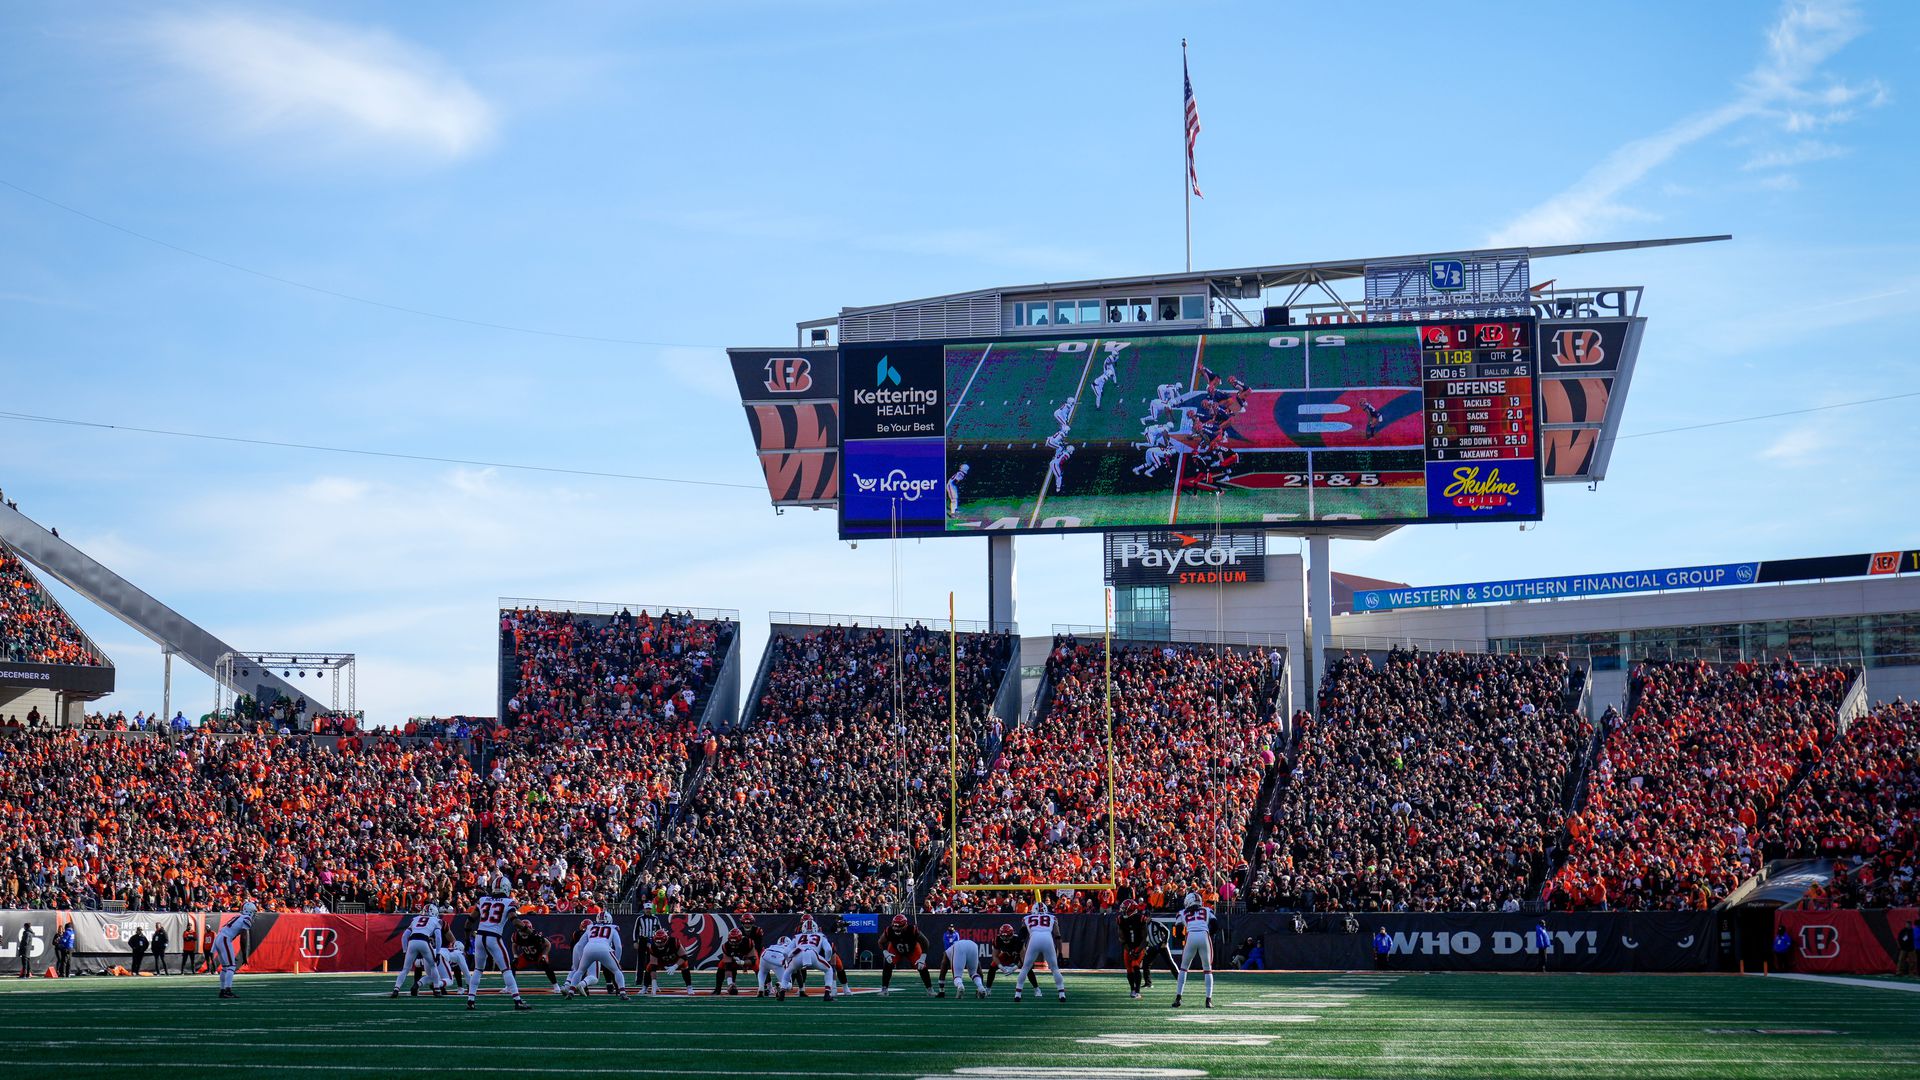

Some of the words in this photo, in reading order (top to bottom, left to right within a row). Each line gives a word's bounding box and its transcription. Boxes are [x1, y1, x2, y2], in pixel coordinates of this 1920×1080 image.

[1480, 290, 1525, 303] BANK
[1458, 330, 1467, 342] 0
[1511, 328, 1521, 340] 7
[1435, 351, 1472, 364] 11:03
[1490, 352, 1506, 360] QTR
[1512, 349, 1522, 362] 2
[1430, 369, 1450, 379] 2ND
[1459, 368, 1466, 377] 5
[1514, 366, 1527, 375] 45
[1447, 381, 1506, 395] DEFENSE
[854, 387, 938, 407] Kettering
[1434, 400, 1445, 409] 19
[1463, 399, 1491, 408] TACKLES
[1509, 397, 1520, 407] 13
[877, 404, 925, 416] HEALTH
[1432, 413, 1447, 422] 0.0
[1467, 412, 1489, 421] SACKS
[1507, 410, 1523, 419] 2.0
[877, 424, 889, 433] Be
[890, 423, 912, 432] Your
[913, 422, 934, 432] Best
[1437, 425, 1443, 434] 0
[1512, 423, 1518, 432] 0
[1433, 437, 1448, 447] 0.0
[1460, 437, 1473, 446] 3RD
[1474, 437, 1493, 445] DOWN
[1505, 435, 1527, 445] 25.0
[1438, 450, 1444, 459] 0
[1460, 450, 1498, 458] TAKEAWAYS
[1515, 448, 1518, 457] 1
[880, 469, 938, 501] Kroger
[1327, 474, 1351, 486] &
[1360, 474, 1379, 485] 5
[1443, 466, 1519, 504] Skyline
[1457, 496, 1503, 504] CHILI
[1179, 571, 1247, 584] STADIUM
[1389, 587, 1461, 605] WESTERN
[1467, 587, 1477, 599] &
[1482, 580, 1567, 599] SOUTHERN
[1574, 574, 1661, 591] FINANCIAL
[1666, 568, 1725, 586] GROUP
[0, 671, 40, 680] DECEMBER
[480, 902, 505, 923] 33
[416, 917, 429, 928] 9
[1027, 915, 1051, 928] 58
[589, 926, 611, 939] 30
[798, 935, 821, 947] 43
[1389, 931, 1481, 954] WHO
